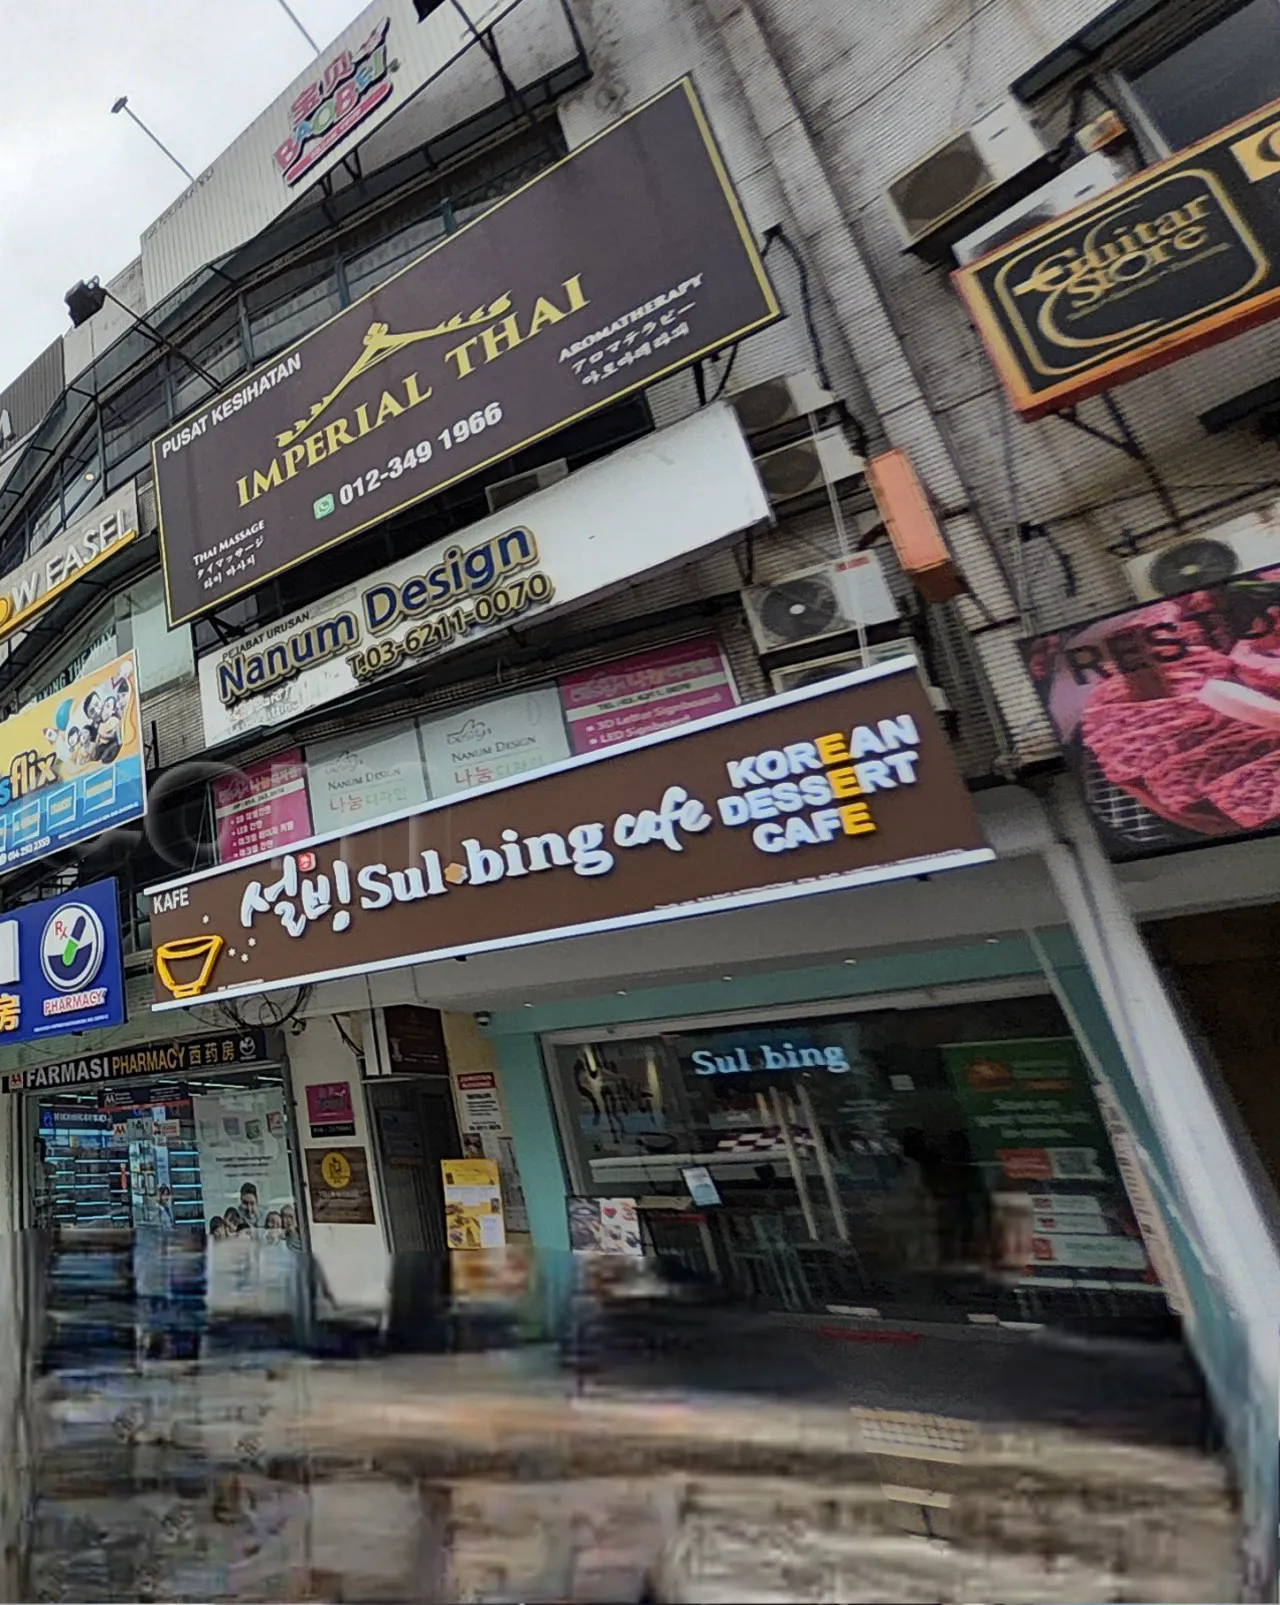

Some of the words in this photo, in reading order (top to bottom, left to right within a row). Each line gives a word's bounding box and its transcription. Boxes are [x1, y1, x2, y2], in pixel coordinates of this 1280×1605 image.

[274, 45, 388, 171] BAOBEI
[162, 414, 208, 459] PUSAT
[211, 352, 302, 426] KESIHATAN
[236, 372, 433, 508] IMPERIAL
[445, 273, 591, 380] THAI
[339, 440, 432, 506] 012-349
[437, 401, 503, 450] 1966
[45, 509, 136, 593] EASEL
[193, 546, 218, 566] THAI
[219, 519, 266, 553] MASSAGE
[217, 610, 361, 701] Nanum
[364, 524, 539, 635] Design
[222, 632, 265, 661] PEJABAT
[267, 611, 310, 639] URUSAN
[726, 714, 920, 789] KOREAN
[613, 785, 714, 852] cafe
[716, 750, 919, 826] DESSERT
[753, 801, 877, 852] CAFE
[152, 887, 190, 914] KAFE
[43, 988, 107, 1016] PHARMACY
[26, 1057, 110, 1088] FARMASI
[112, 1046, 188, 1077] PHARMACY
[189, 1040, 235, 1066] 西药房
[691, 1047, 753, 1075] Sul
[759, 1042, 851, 1074] bing
